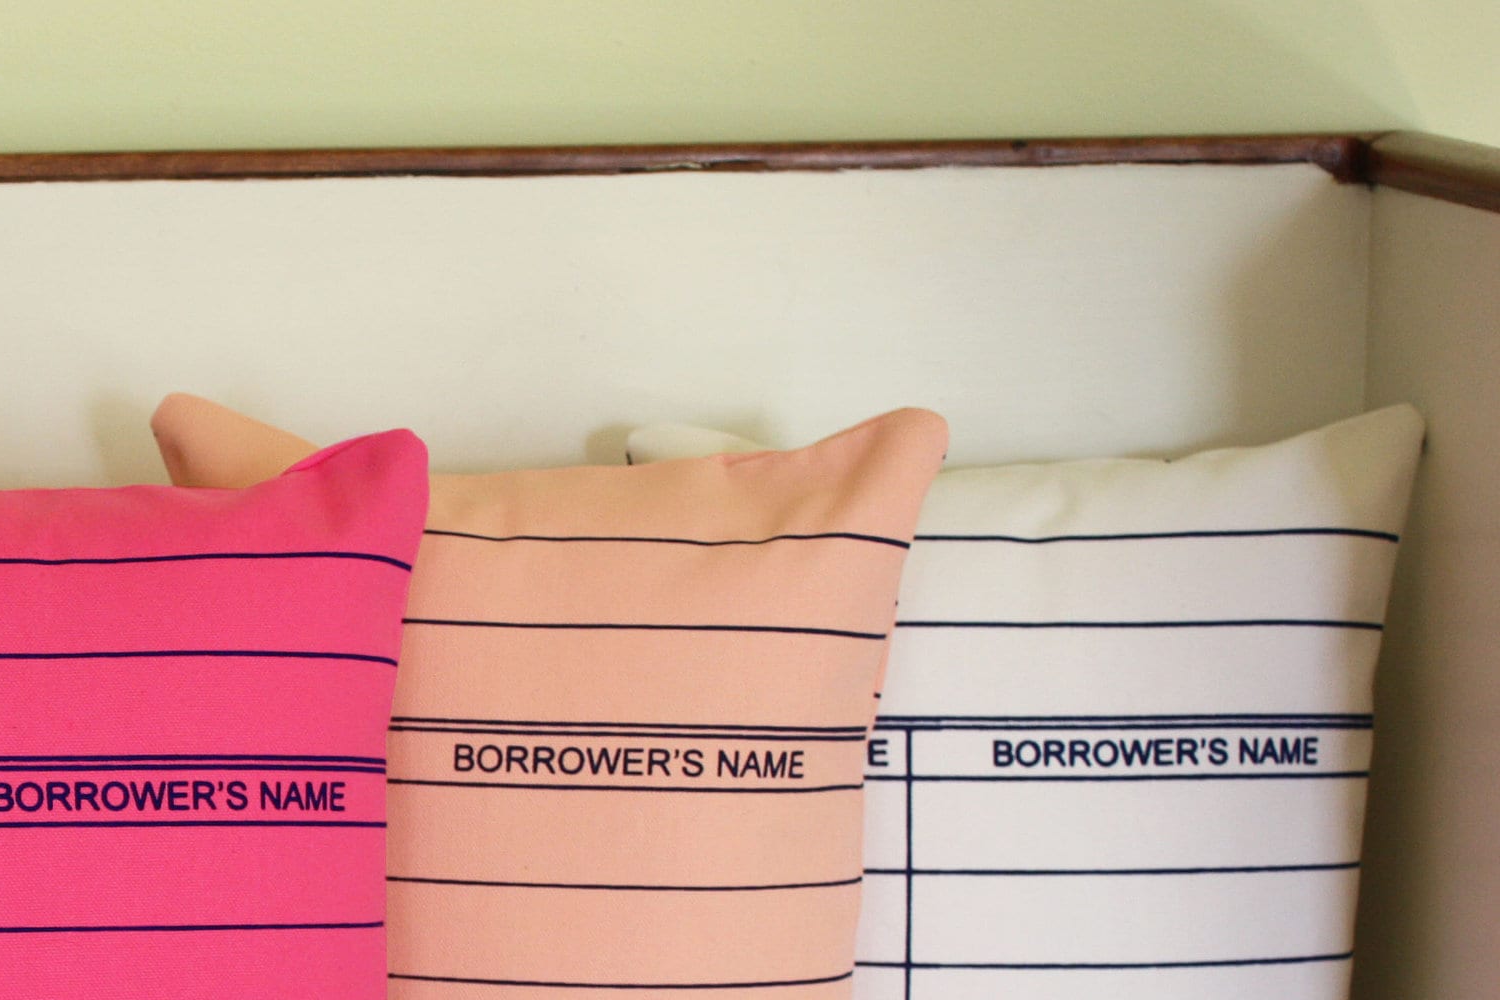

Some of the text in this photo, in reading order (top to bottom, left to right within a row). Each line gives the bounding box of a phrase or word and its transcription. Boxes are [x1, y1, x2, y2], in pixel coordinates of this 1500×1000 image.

[453, 743, 805, 779] BORROWER'S NAME
[993, 736, 1319, 768] BORROWER'S NAME
[260, 780, 346, 812] NAME
